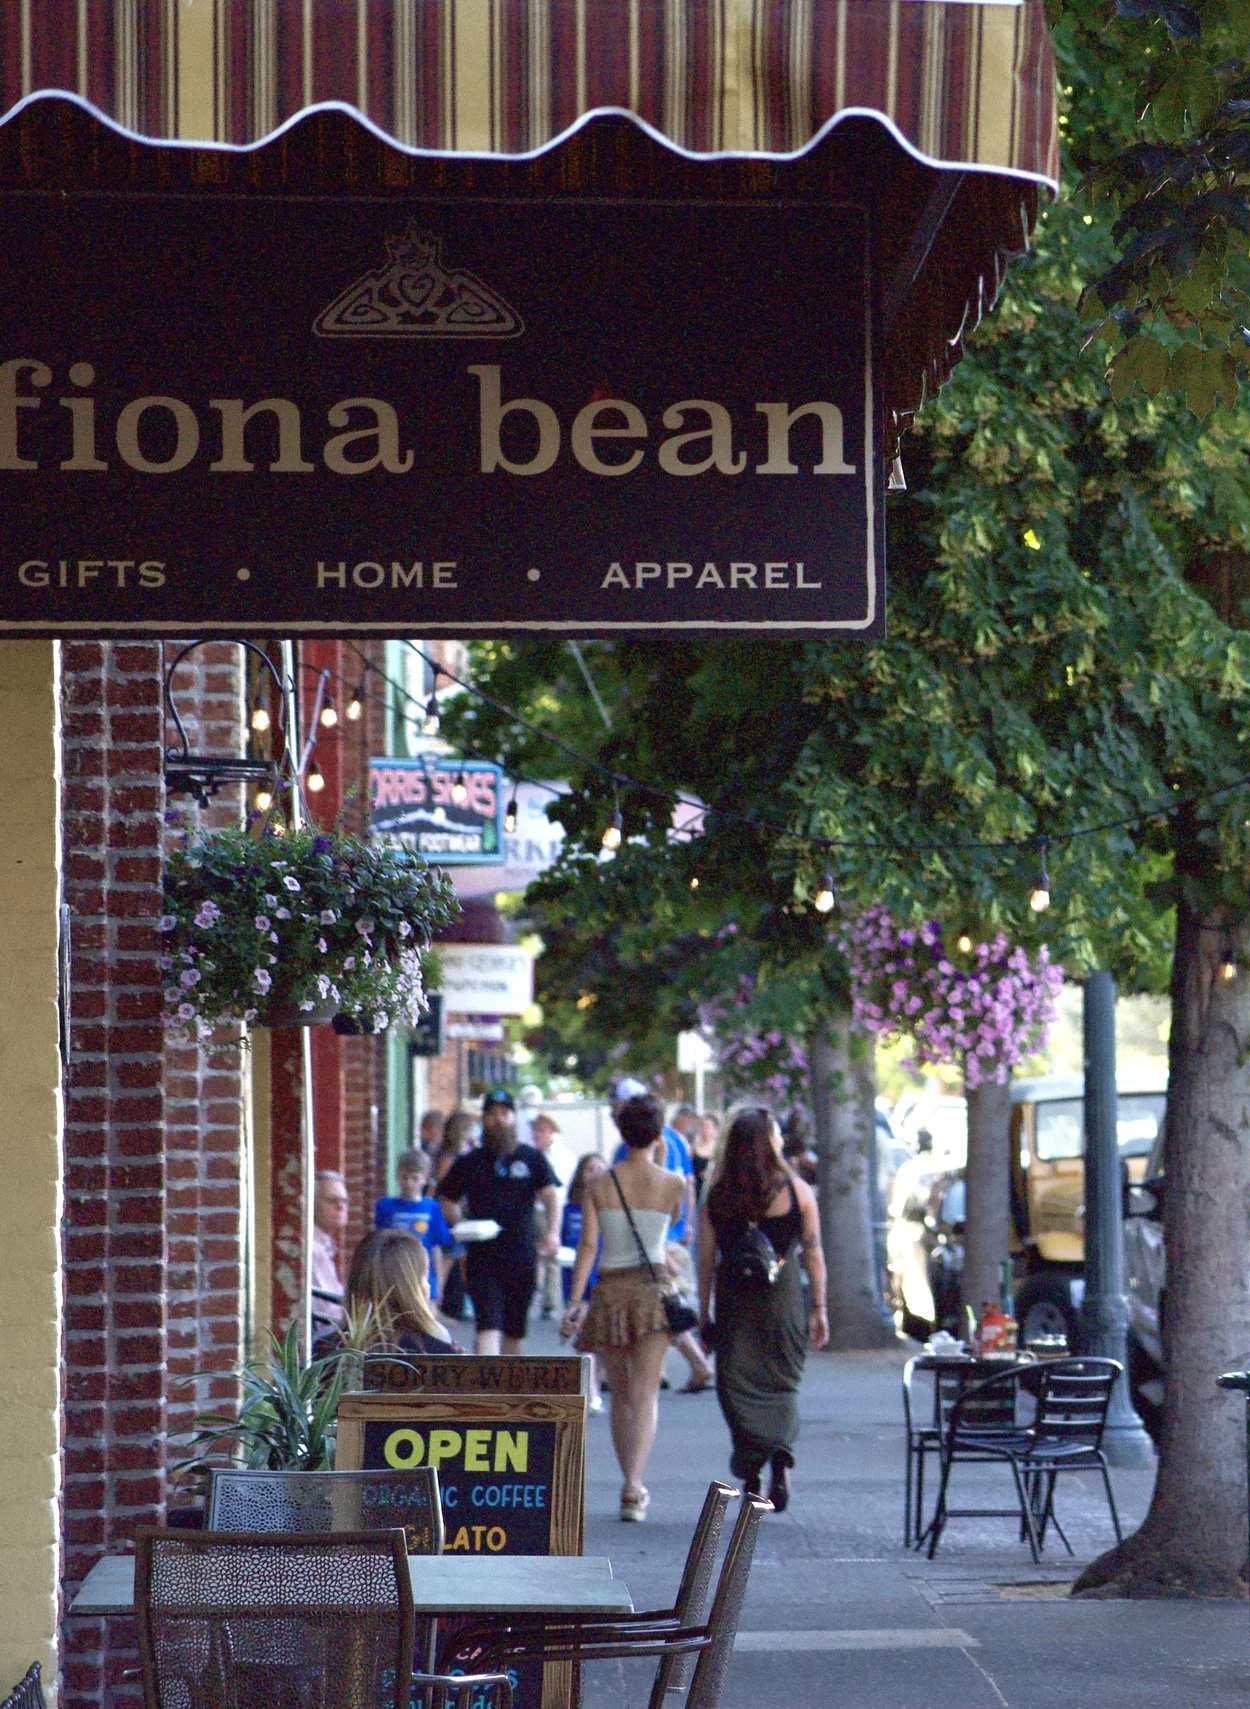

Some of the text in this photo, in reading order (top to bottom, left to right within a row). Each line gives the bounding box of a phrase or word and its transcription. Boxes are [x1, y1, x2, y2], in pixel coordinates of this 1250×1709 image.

[0, 358, 857, 477] fiona bean
[17, 560, 823, 590] GIFTS HOME APPAREL
[383, 1428, 529, 1473] OPEN
[471, 1484, 546, 1507] COFFEE
